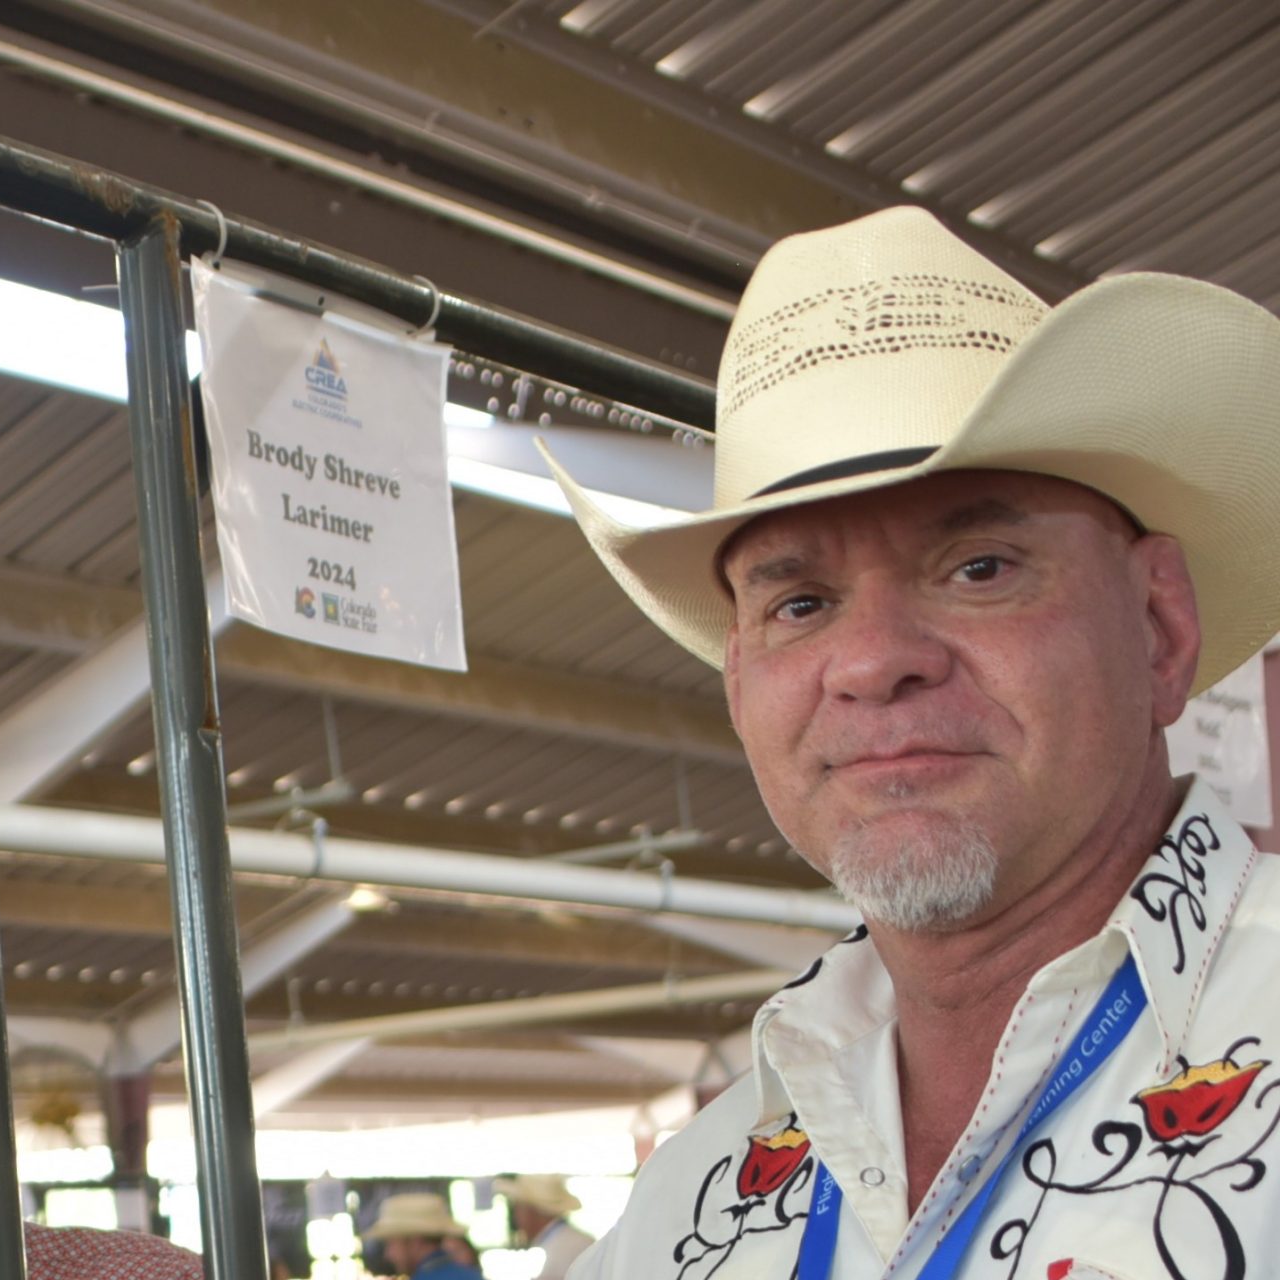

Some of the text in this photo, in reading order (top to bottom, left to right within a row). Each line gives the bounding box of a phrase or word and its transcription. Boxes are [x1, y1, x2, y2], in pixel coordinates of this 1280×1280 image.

[305, 366, 347, 395] CREA
[246, 429, 401, 500] Brody Shreve
[282, 494, 374, 544] Larimer
[307, 556, 357, 592] 2024
[1021, 989, 1133, 1133] raining Center
